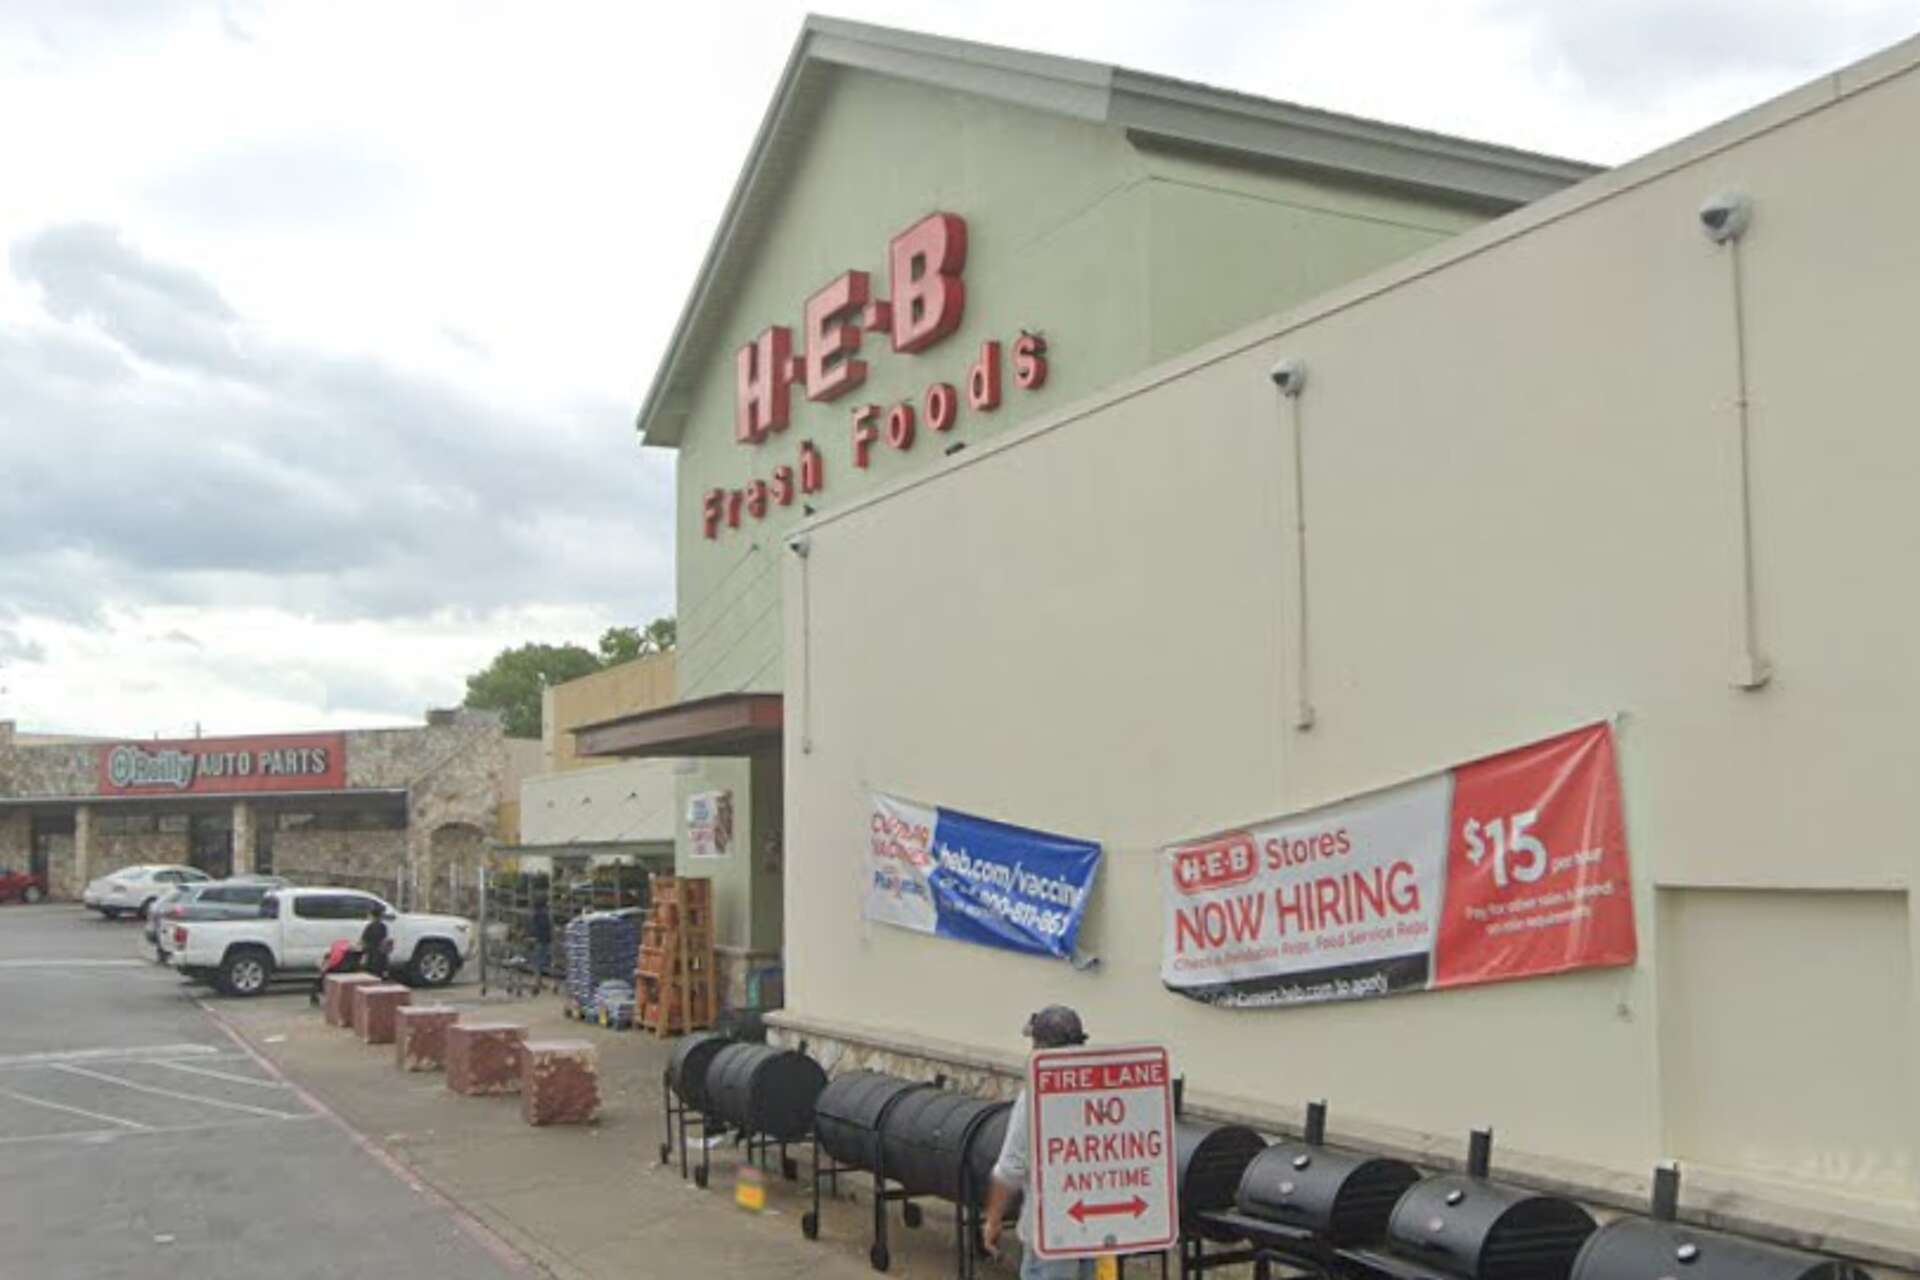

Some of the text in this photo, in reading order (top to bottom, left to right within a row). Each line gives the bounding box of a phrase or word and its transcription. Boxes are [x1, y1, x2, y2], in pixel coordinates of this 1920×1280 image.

[703, 332, 1048, 539] Fresh Foods
[200, 752, 250, 776] AUTO
[259, 747, 327, 776] PARTS
[1265, 827, 1351, 871] Stores
[1464, 808, 1548, 888] $15
[1175, 889, 1265, 954] NOW
[1276, 860, 1420, 937] HIRING
[1038, 1063, 1164, 1091] FIRE LANE
[1084, 1096, 1125, 1126] NO
[1047, 1130, 1162, 1165] PARKING
[1062, 1167, 1151, 1193] ANYTIME
